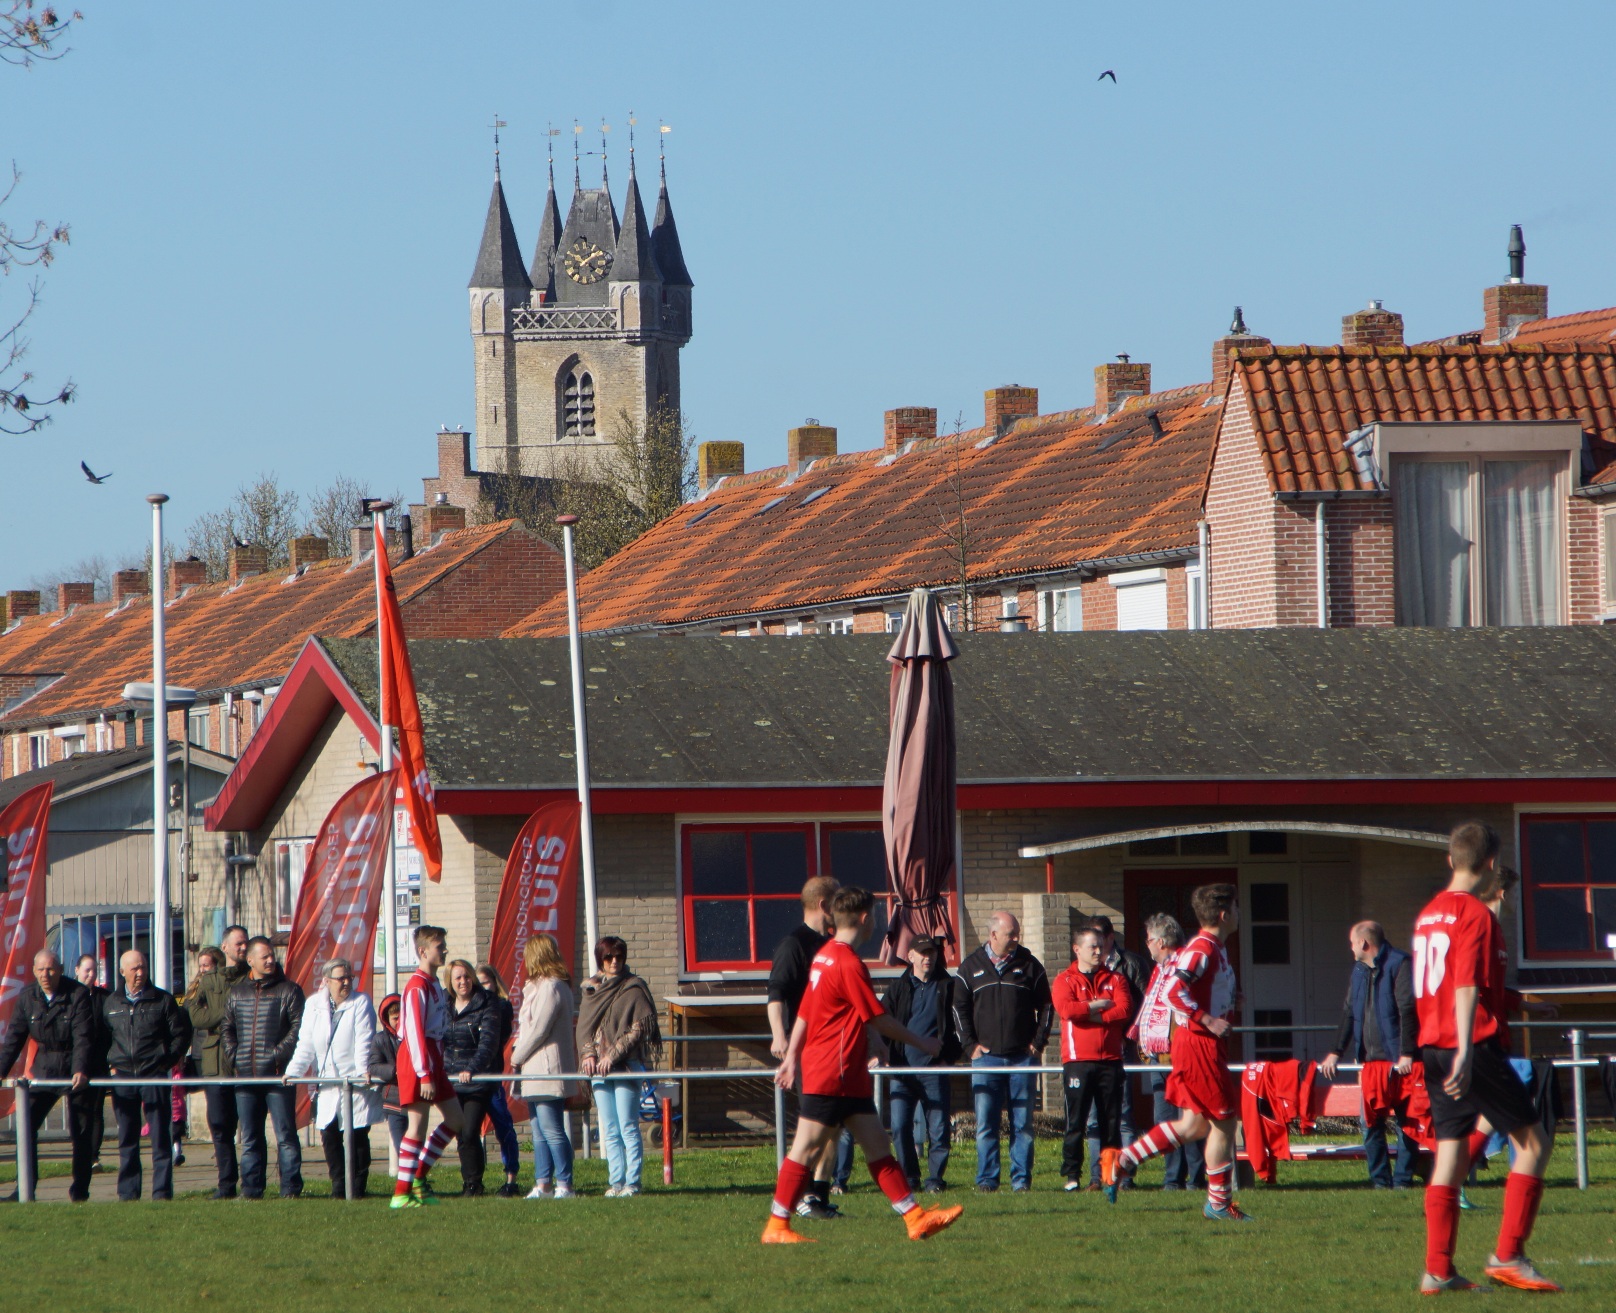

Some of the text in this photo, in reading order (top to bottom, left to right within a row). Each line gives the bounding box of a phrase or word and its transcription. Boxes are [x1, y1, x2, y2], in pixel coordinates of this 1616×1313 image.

[4, 827, 36, 955] SLUIS
[332, 814, 378, 945] SLUIS
[532, 835, 566, 947] LUIS
[1412, 931, 1451, 999] 10
[1068, 1078, 1081, 1089] JG
